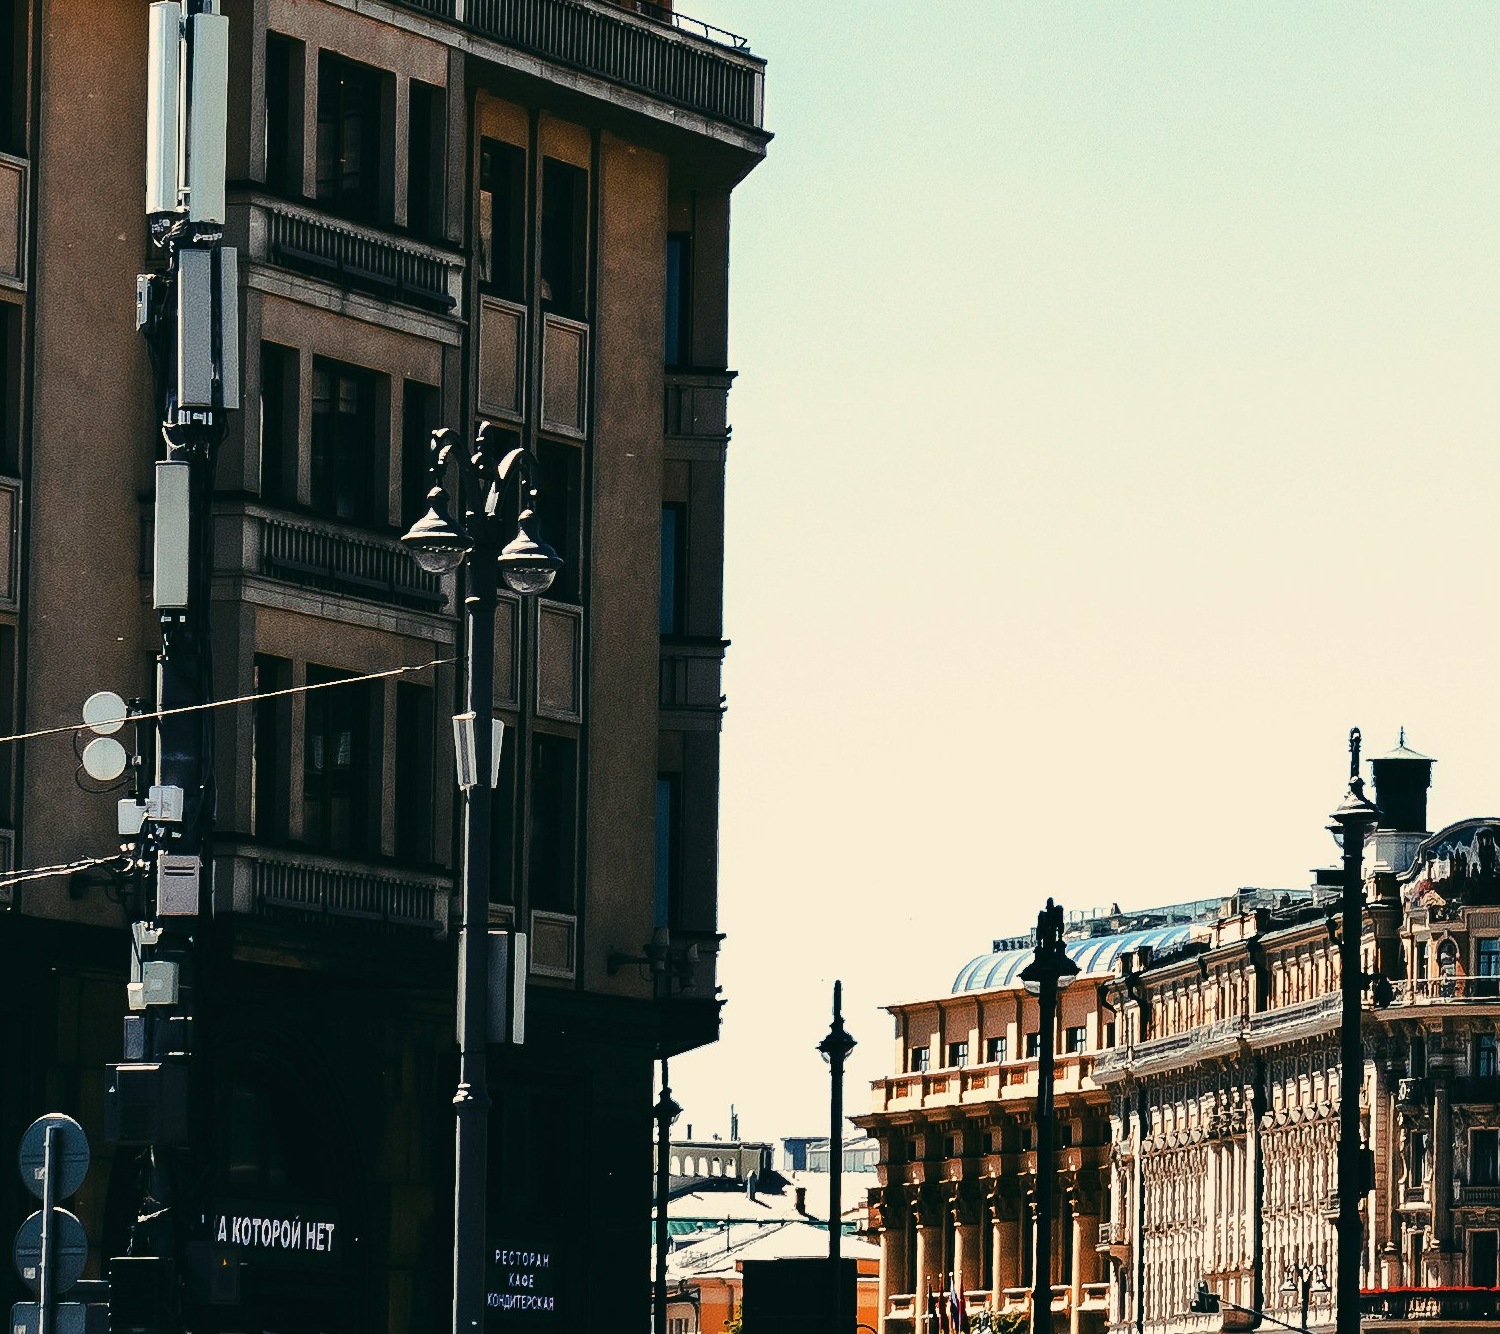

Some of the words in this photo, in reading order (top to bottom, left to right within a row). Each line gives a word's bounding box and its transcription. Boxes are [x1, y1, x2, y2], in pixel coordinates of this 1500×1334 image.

[231, 1214, 301, 1249] КОТОРОЙ
[305, 1222, 335, 1252] НЕТ
[495, 1249, 549, 1268] РЕСТОРАН
[508, 1272, 534, 1288] КАФЕ
[487, 1292, 554, 1311] КОНДИТЕРСКАЯ
